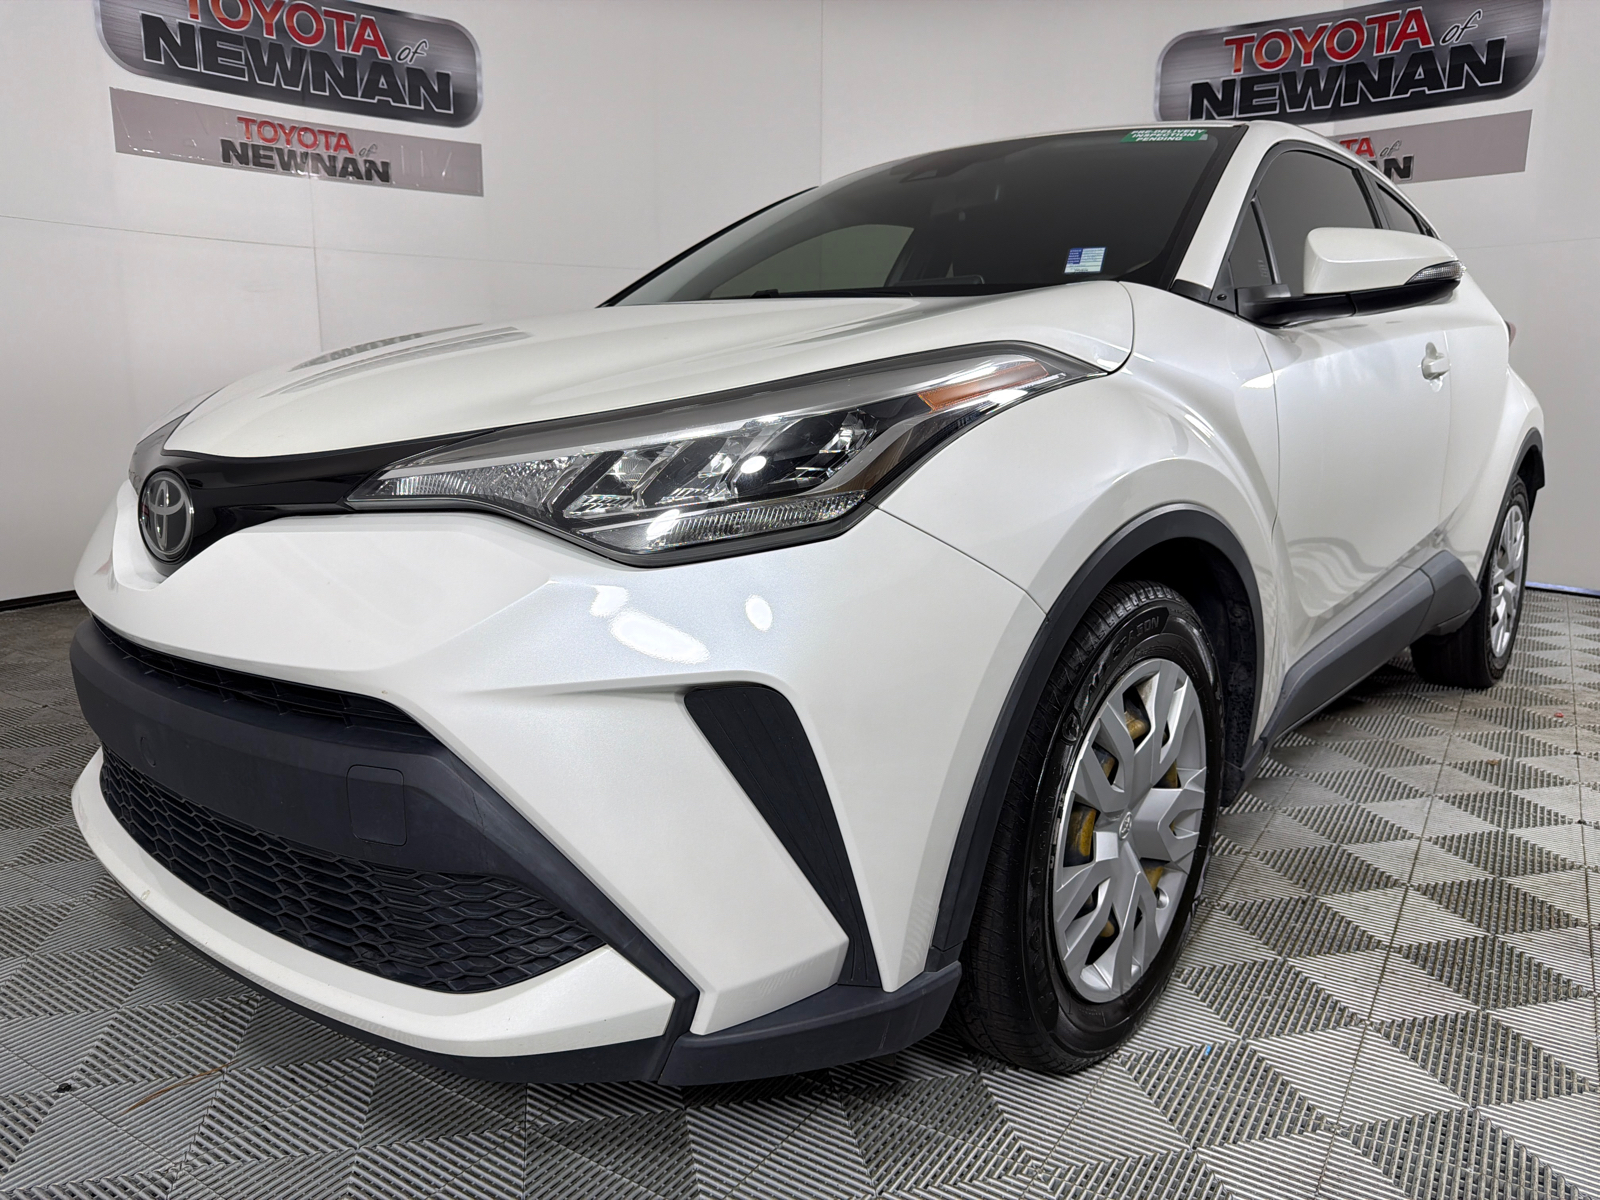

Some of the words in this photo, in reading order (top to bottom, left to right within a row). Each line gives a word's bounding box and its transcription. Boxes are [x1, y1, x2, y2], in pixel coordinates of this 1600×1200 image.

[139, 11, 455, 114] NEWNAN
[395, 40, 429, 63] of
[1223, 6, 1434, 75] TOYOTA
[1440, 10, 1482, 46] of
[1189, 36, 1507, 120] NEWNAN
[237, 116, 355, 154] TOYOTA
[358, 143, 378, 158] of
[1380, 140, 1402, 157] of
[220, 138, 391, 183] NEWNAN
